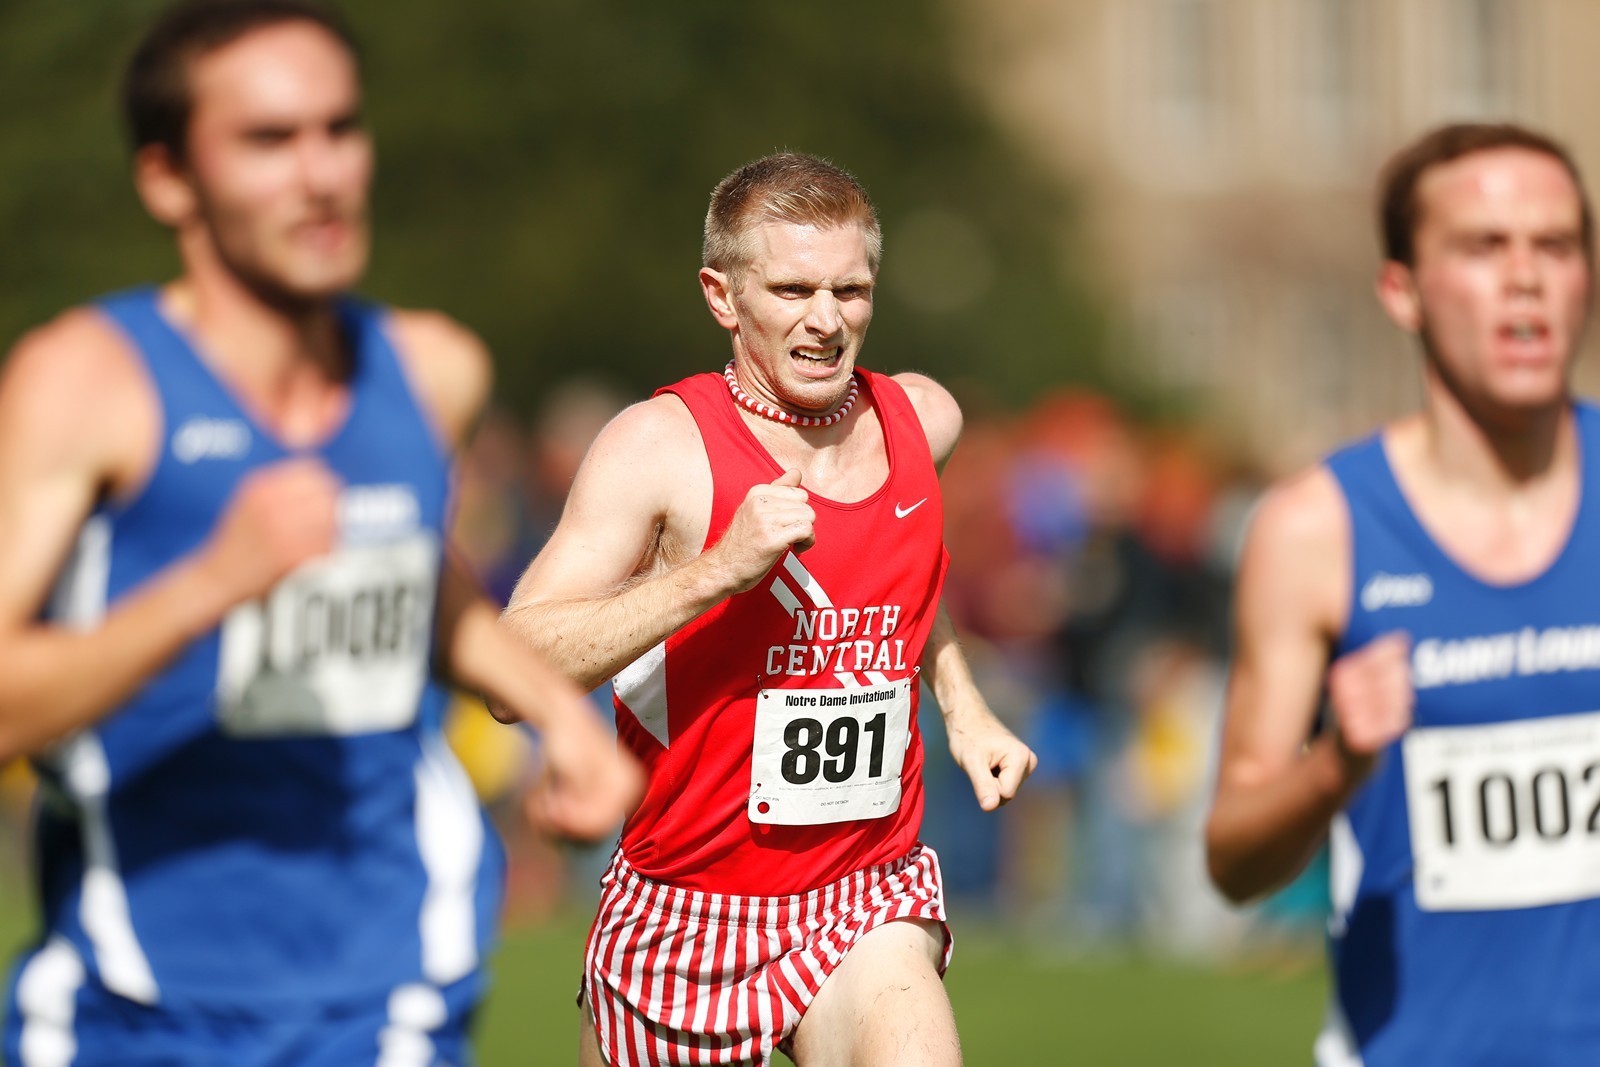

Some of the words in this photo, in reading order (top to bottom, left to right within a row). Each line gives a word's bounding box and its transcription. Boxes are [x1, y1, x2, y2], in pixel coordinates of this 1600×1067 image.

[793, 605, 901, 641] NORTH
[765, 639, 907, 676] CENTRAL
[785, 695, 817, 707] Notre
[819, 695, 848, 707] Dame
[849, 687, 897, 705] Invitational
[780, 712, 887, 785] 891
[1426, 760, 1600, 850] 1002
